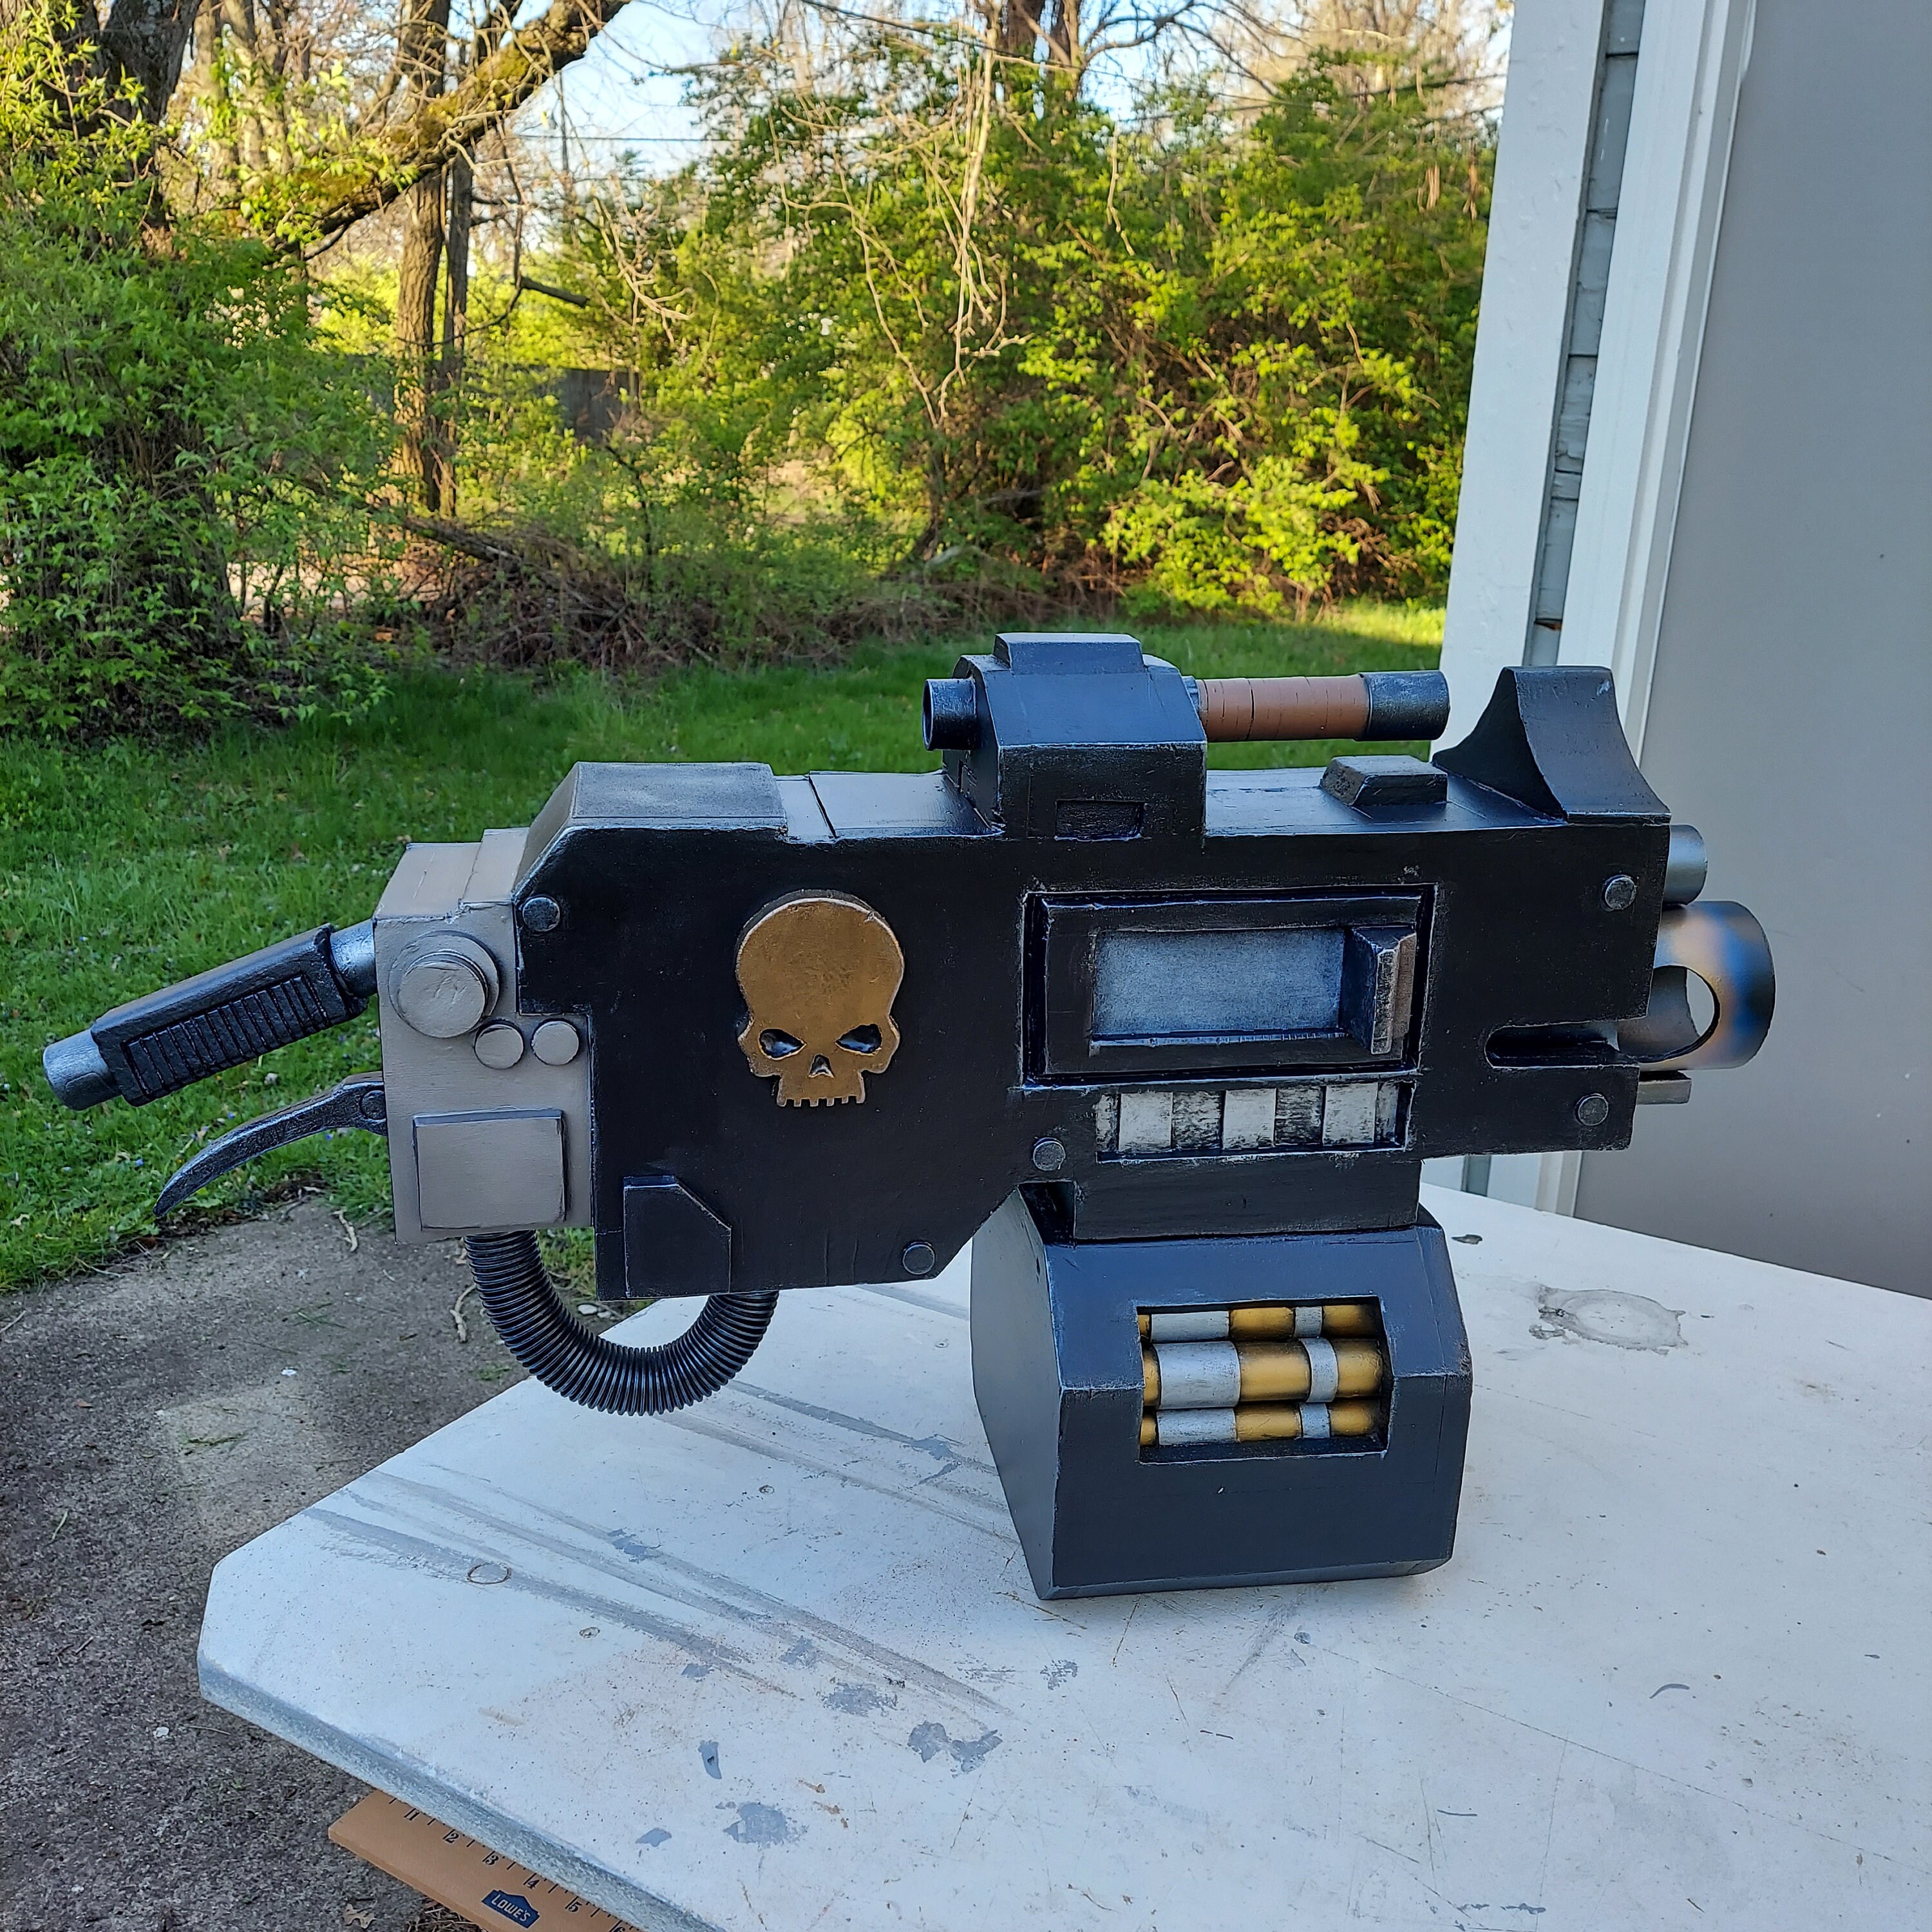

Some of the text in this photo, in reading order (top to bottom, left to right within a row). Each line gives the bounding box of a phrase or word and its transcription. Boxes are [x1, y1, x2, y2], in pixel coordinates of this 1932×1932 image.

[445, 1832, 459, 1844] 2
[485, 1855, 499, 1866] 3
[527, 1879, 540, 1889] 4
[568, 1901, 583, 1913] 5
[491, 1893, 531, 1922] LOWE'S
